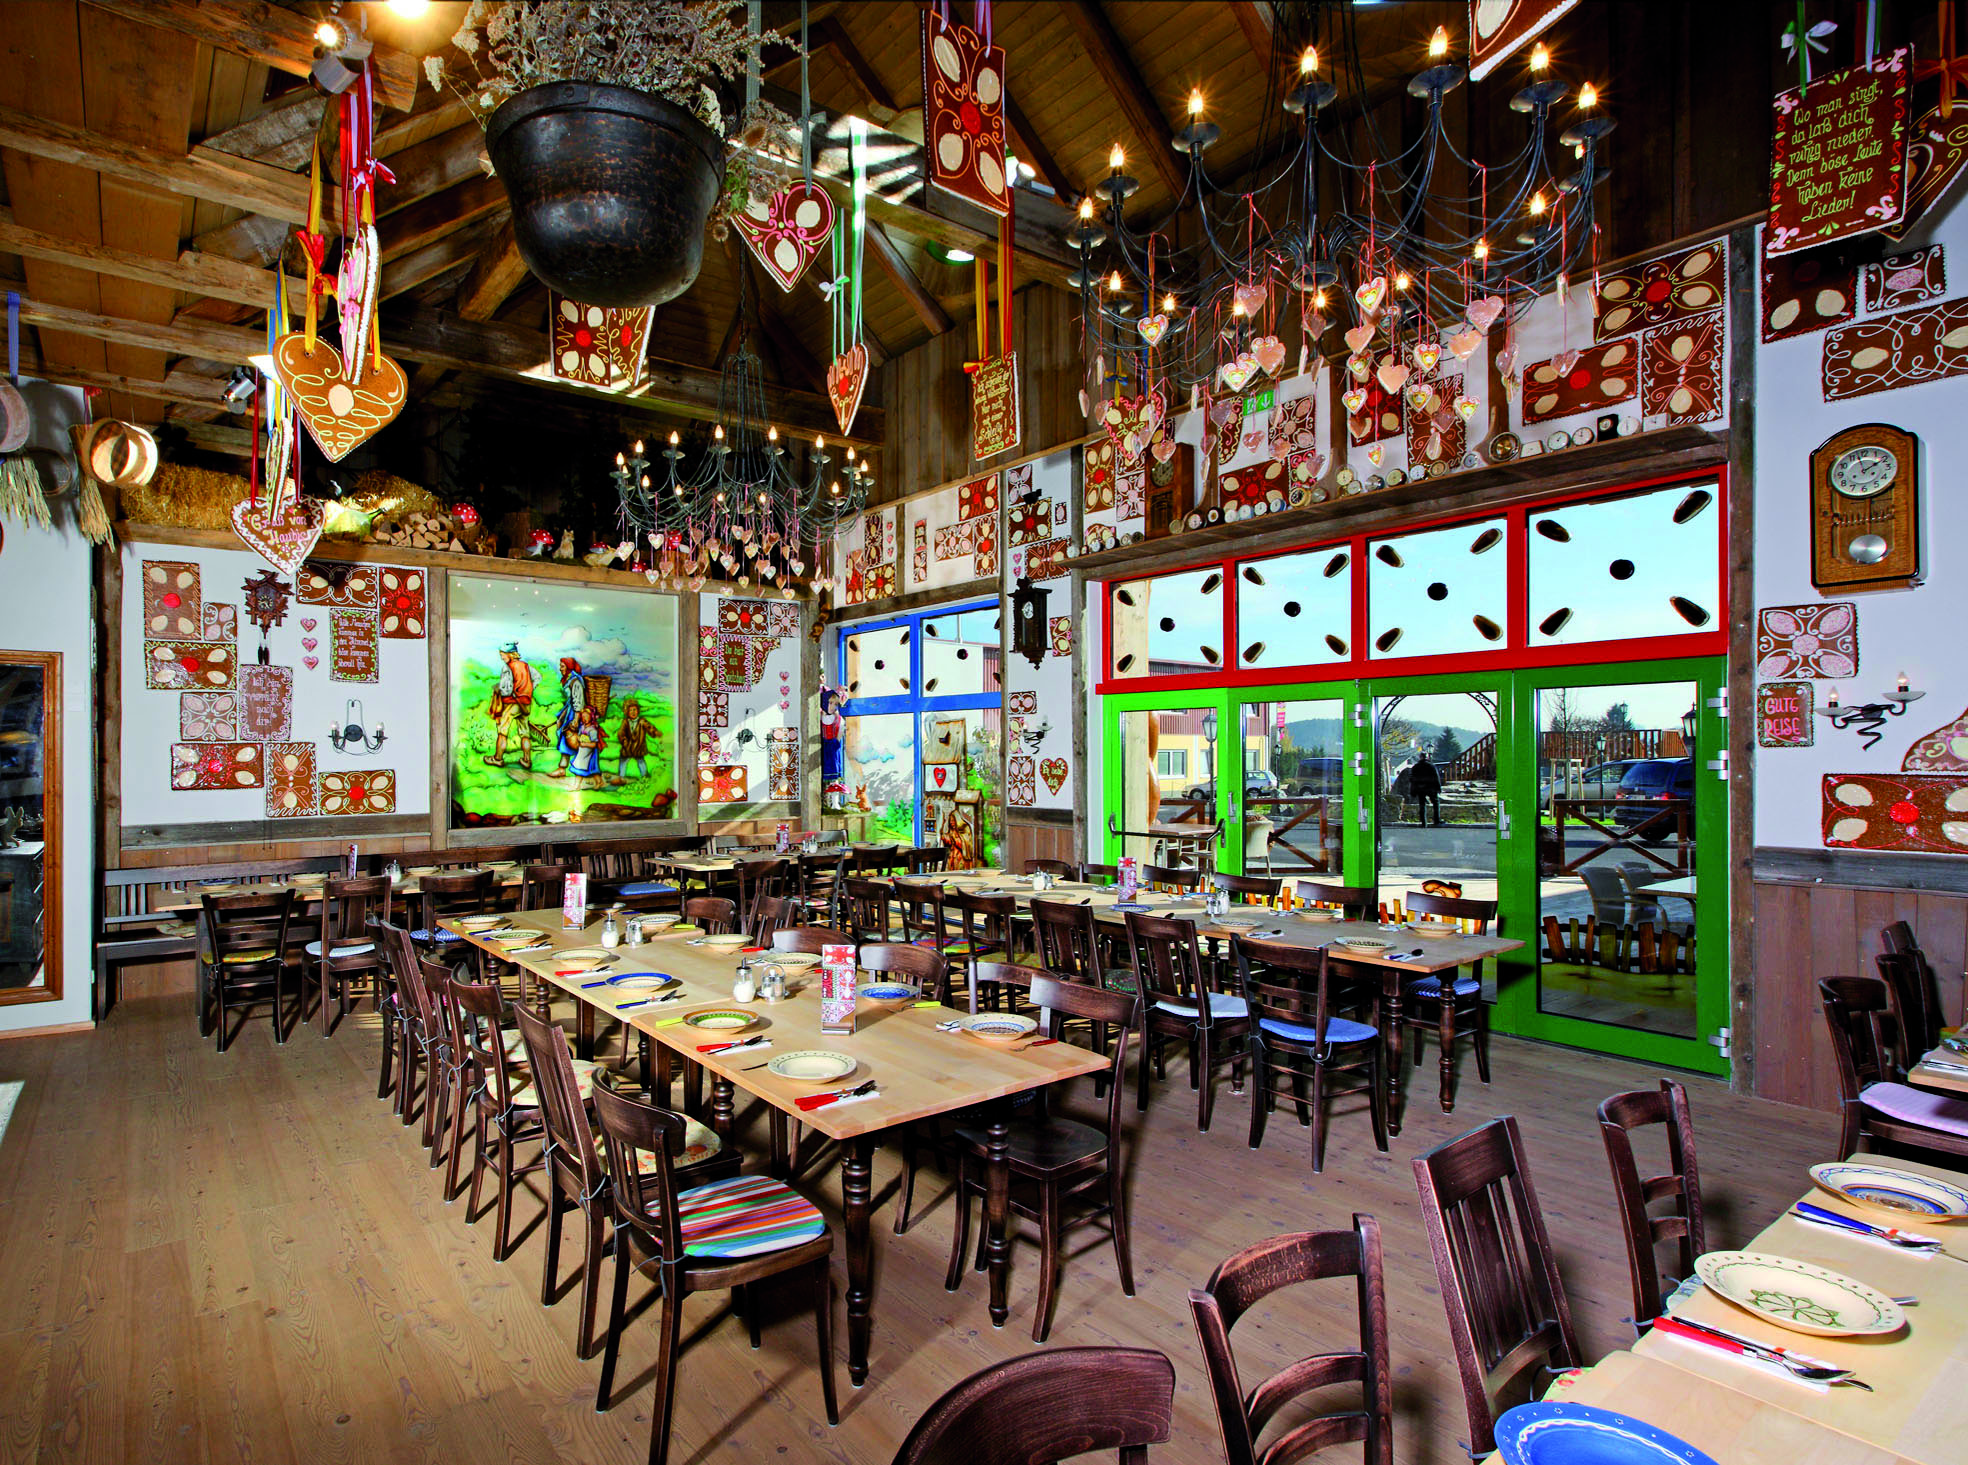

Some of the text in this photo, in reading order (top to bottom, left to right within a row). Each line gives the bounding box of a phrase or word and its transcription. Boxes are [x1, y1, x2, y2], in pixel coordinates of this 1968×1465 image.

[1794, 79, 1883, 125] Wo man singt,
[1792, 130, 1805, 145] da
[1838, 104, 1874, 128] dich
[1786, 139, 1883, 187] Denn böse Leute
[1789, 126, 1874, 164] ruhig nieder.
[1797, 166, 1874, 205] haben keine
[1801, 190, 1856, 222] Lieder!
[289, 516, 307, 525] von
[1764, 697, 1799, 715] GUTE
[1763, 717, 1801, 738] REISE
